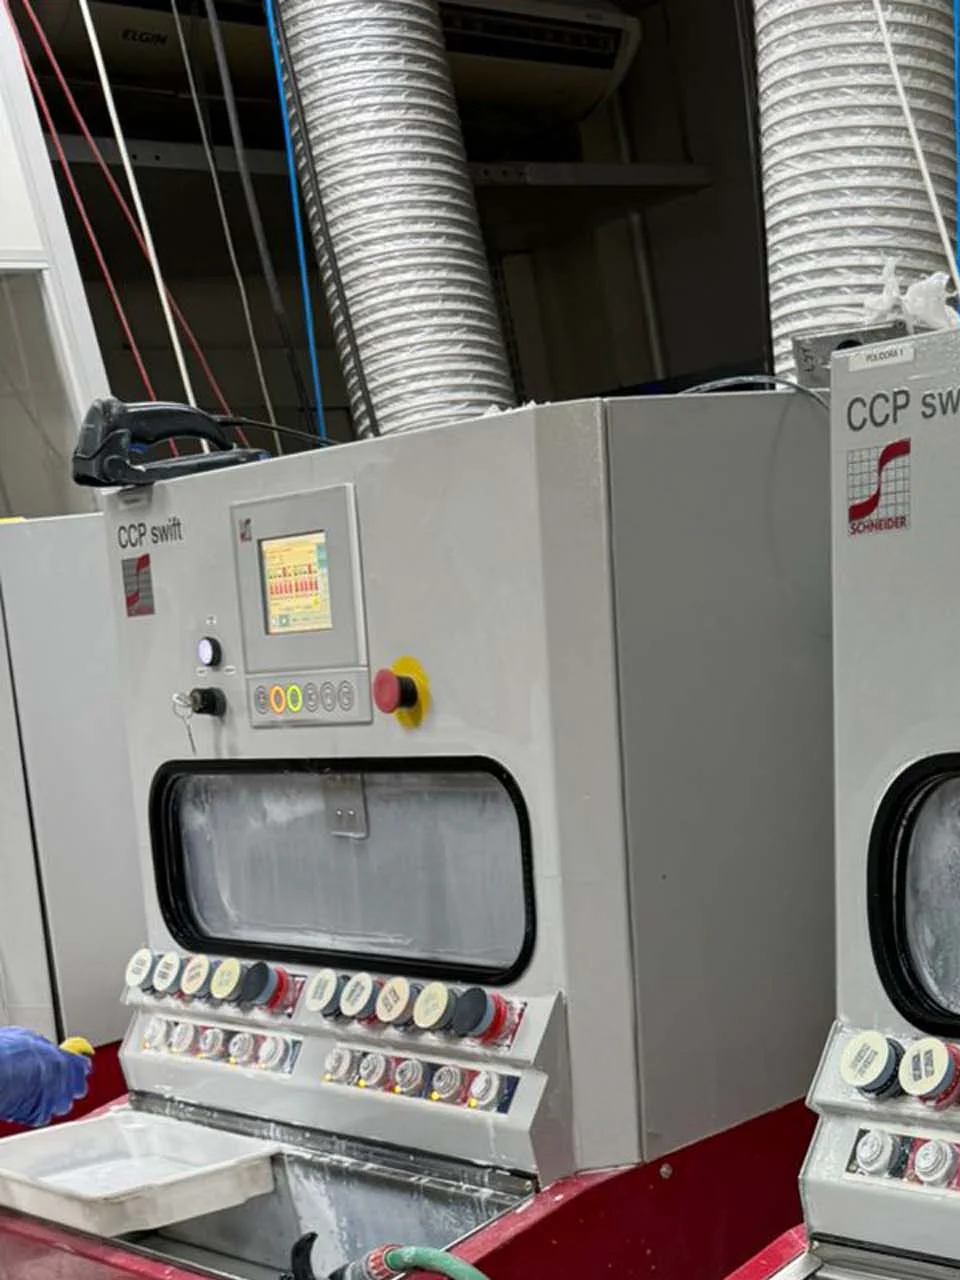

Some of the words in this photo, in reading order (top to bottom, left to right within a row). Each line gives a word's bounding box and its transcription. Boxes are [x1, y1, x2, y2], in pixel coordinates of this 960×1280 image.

[847, 389, 911, 432] CCP
[118, 522, 147, 549] CCP
[151, 516, 182, 544] swift
[849, 516, 907, 535] SCHNEIDER
